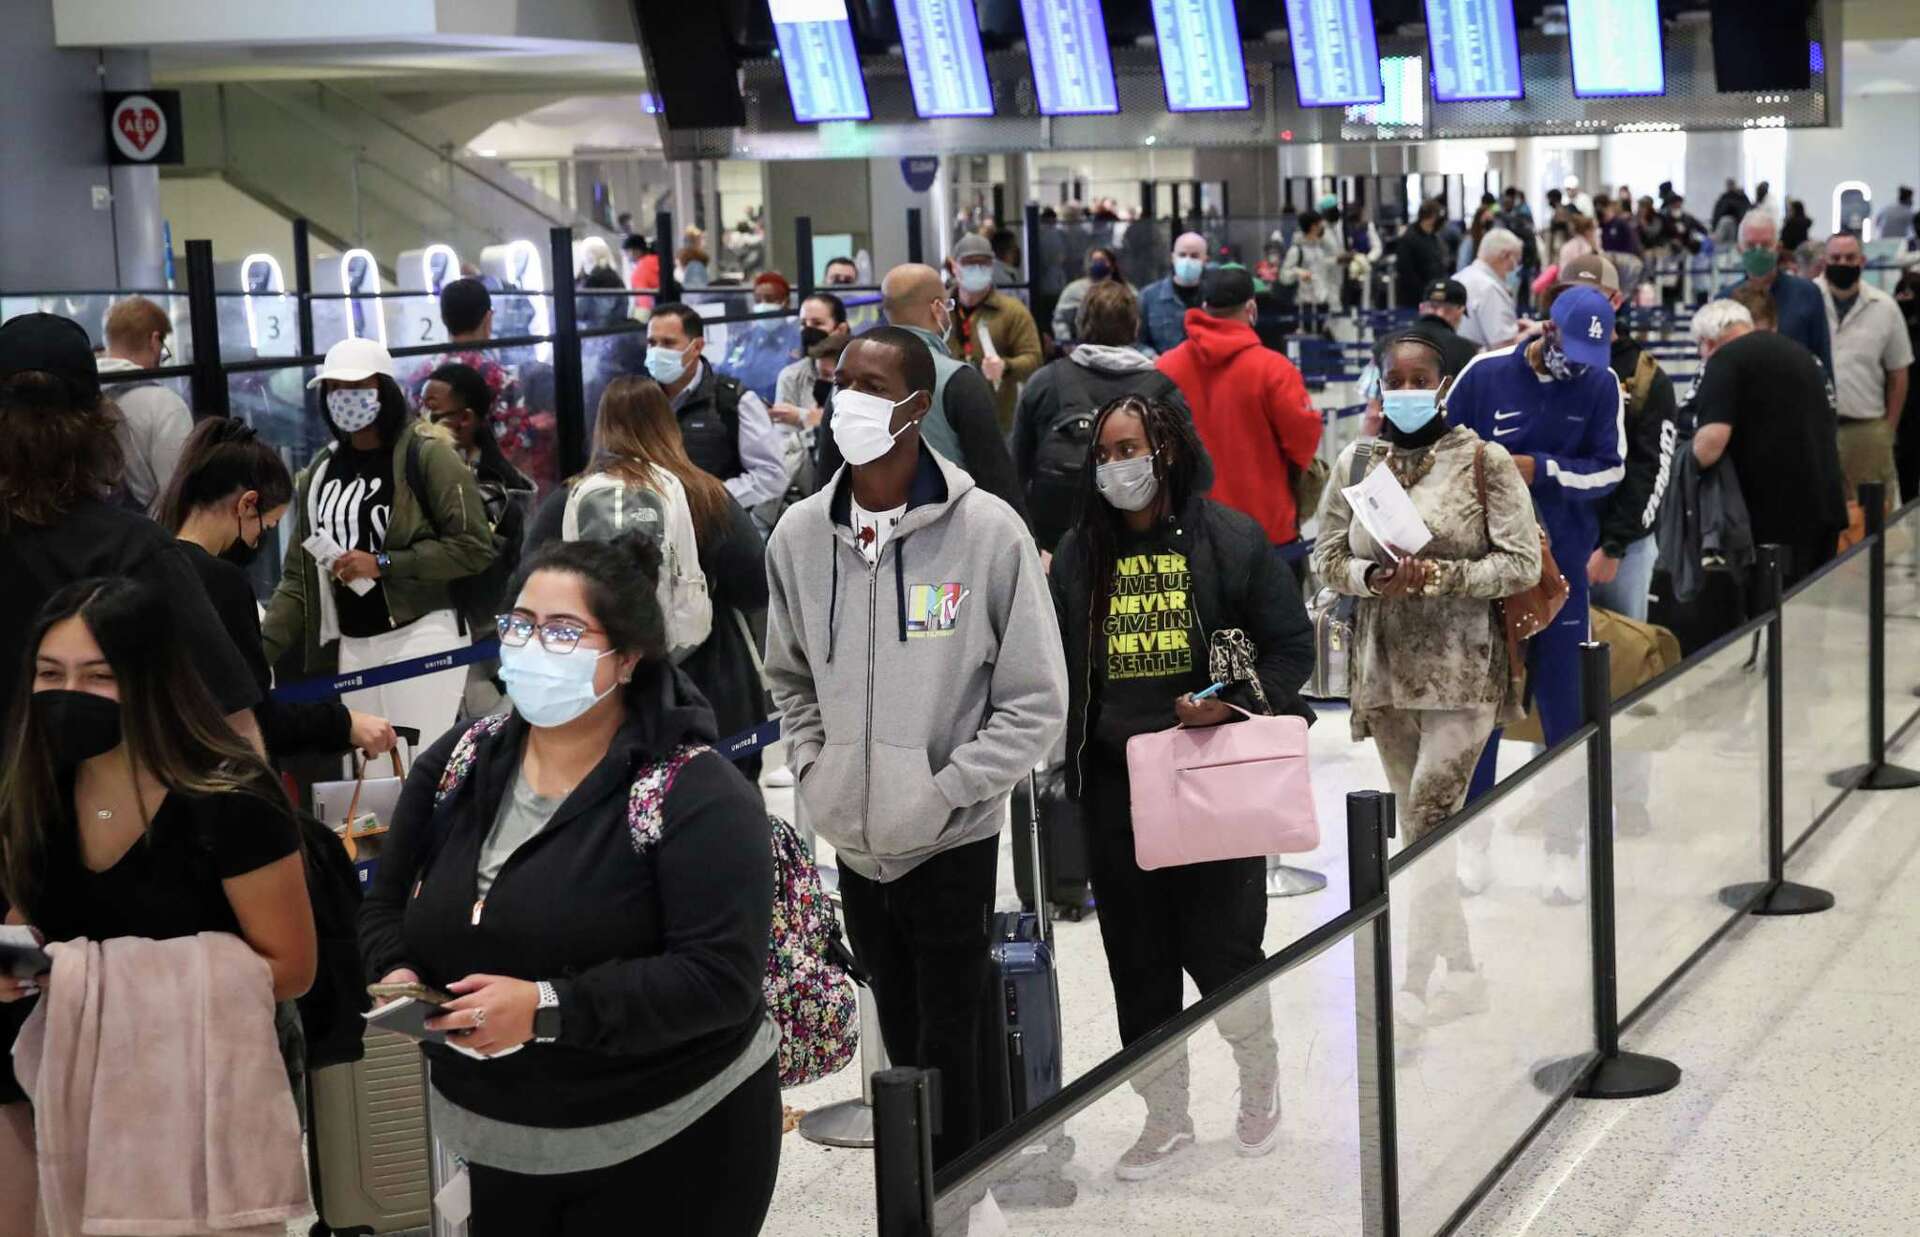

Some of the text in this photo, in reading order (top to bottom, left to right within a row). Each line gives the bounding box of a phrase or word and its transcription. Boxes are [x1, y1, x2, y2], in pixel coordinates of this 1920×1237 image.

[124, 117, 156, 133] AED
[267, 316, 281, 339] 3
[420, 317, 434, 341] 2
[1588, 316, 1604, 338] LA
[1117, 554, 1188, 575] NEVER
[1110, 591, 1187, 616] NEVER
[1102, 609, 1193, 635] GIVE IN
[1108, 629, 1190, 655] NEVER
[1107, 649, 1192, 673] SETTLE
